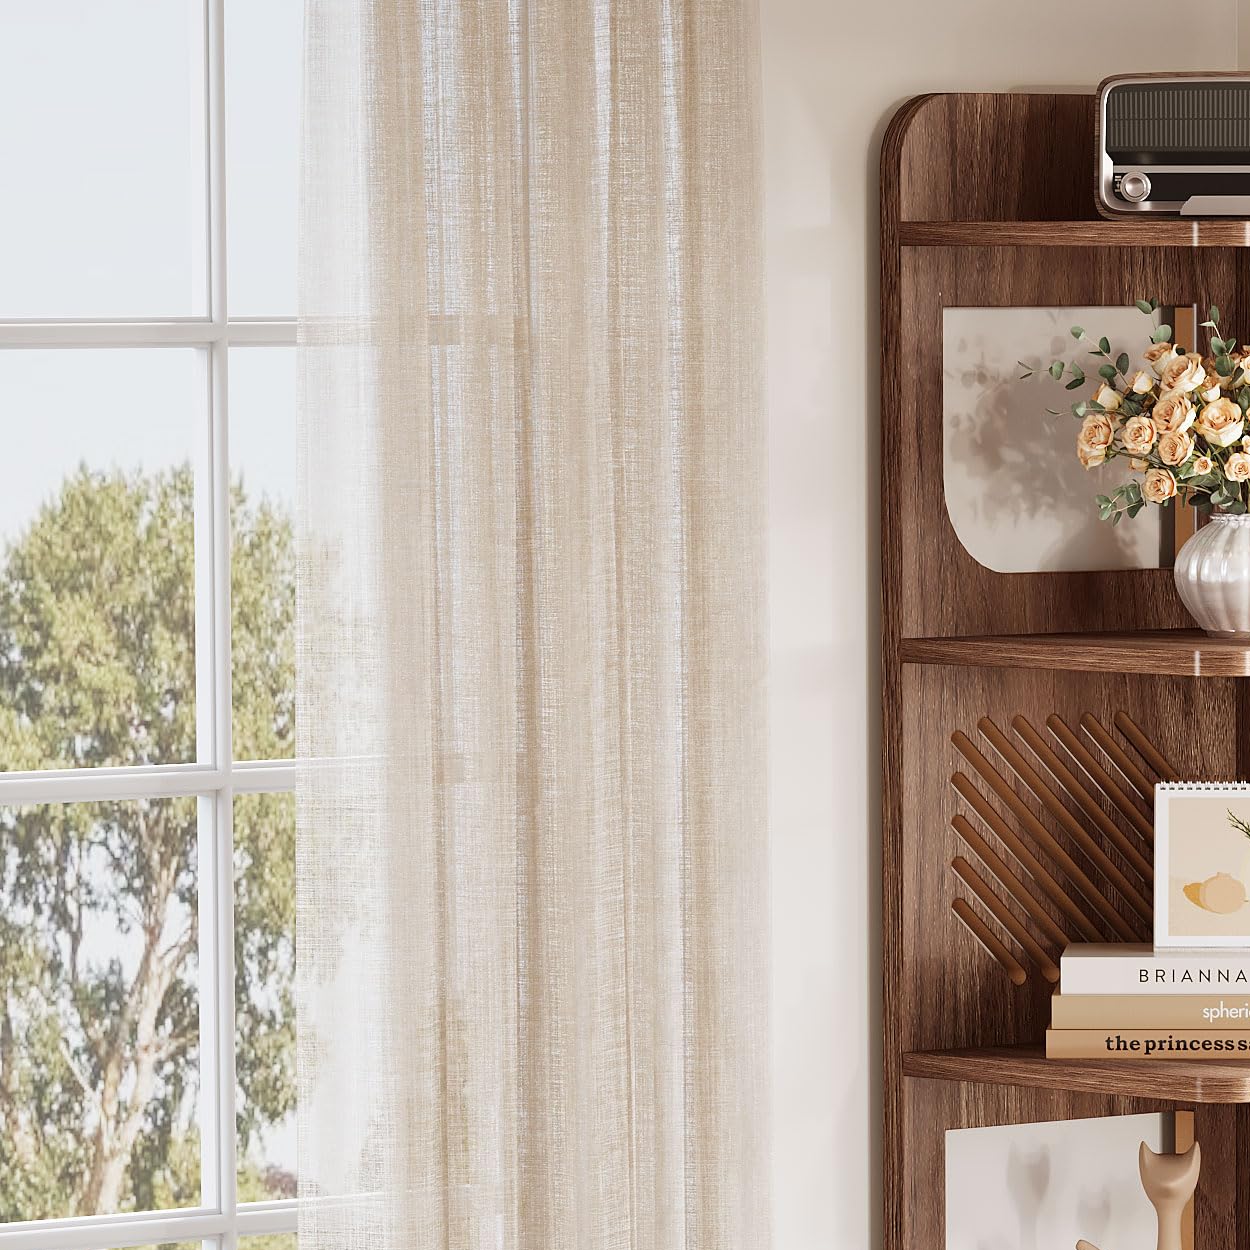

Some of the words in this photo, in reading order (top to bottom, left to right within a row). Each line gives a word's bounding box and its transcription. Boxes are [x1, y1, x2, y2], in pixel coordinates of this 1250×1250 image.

[1139, 968, 1248, 983] BRIANNA
[1104, 1035, 1141, 1051] the
[1143, 1034, 1235, 1056] princess
